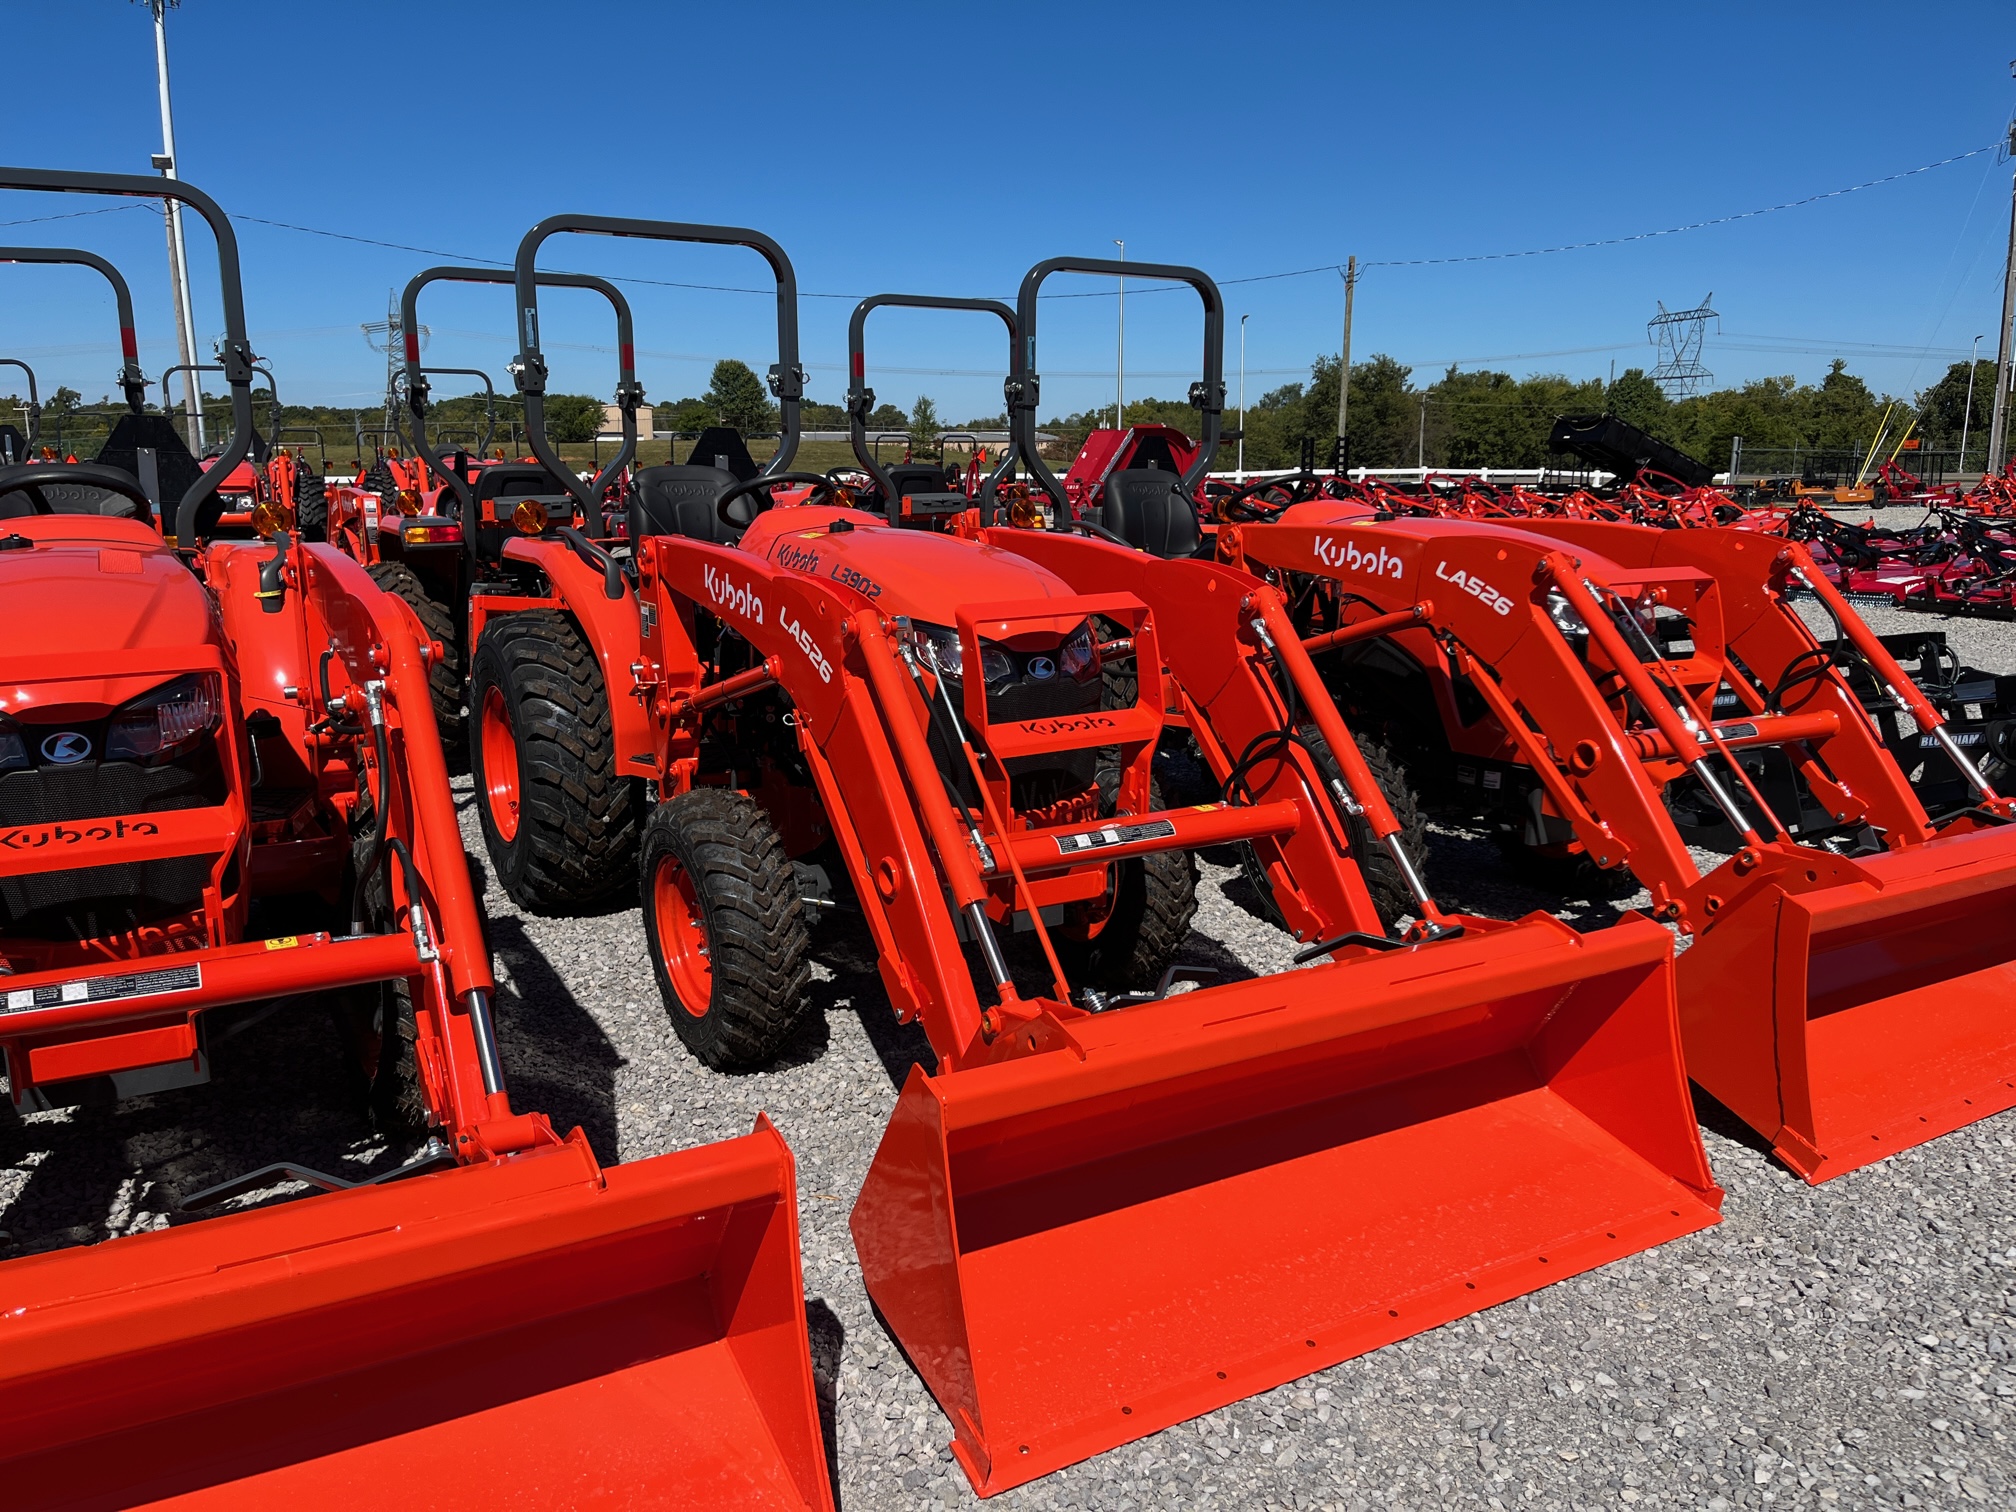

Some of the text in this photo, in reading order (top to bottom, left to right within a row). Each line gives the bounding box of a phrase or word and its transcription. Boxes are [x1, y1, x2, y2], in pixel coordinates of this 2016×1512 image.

[43, 487, 100, 500] ubota
[665, 484, 716, 497] Kubota
[777, 543, 882, 603] Kubota L3902
[1313, 536, 1403, 579] Kubota
[704, 563, 763, 625] Kubota
[1435, 560, 1515, 616] LA526
[779, 605, 834, 684] LA526
[1019, 716, 1117, 735] Kubota
[0, 819, 159, 849] Kubota
